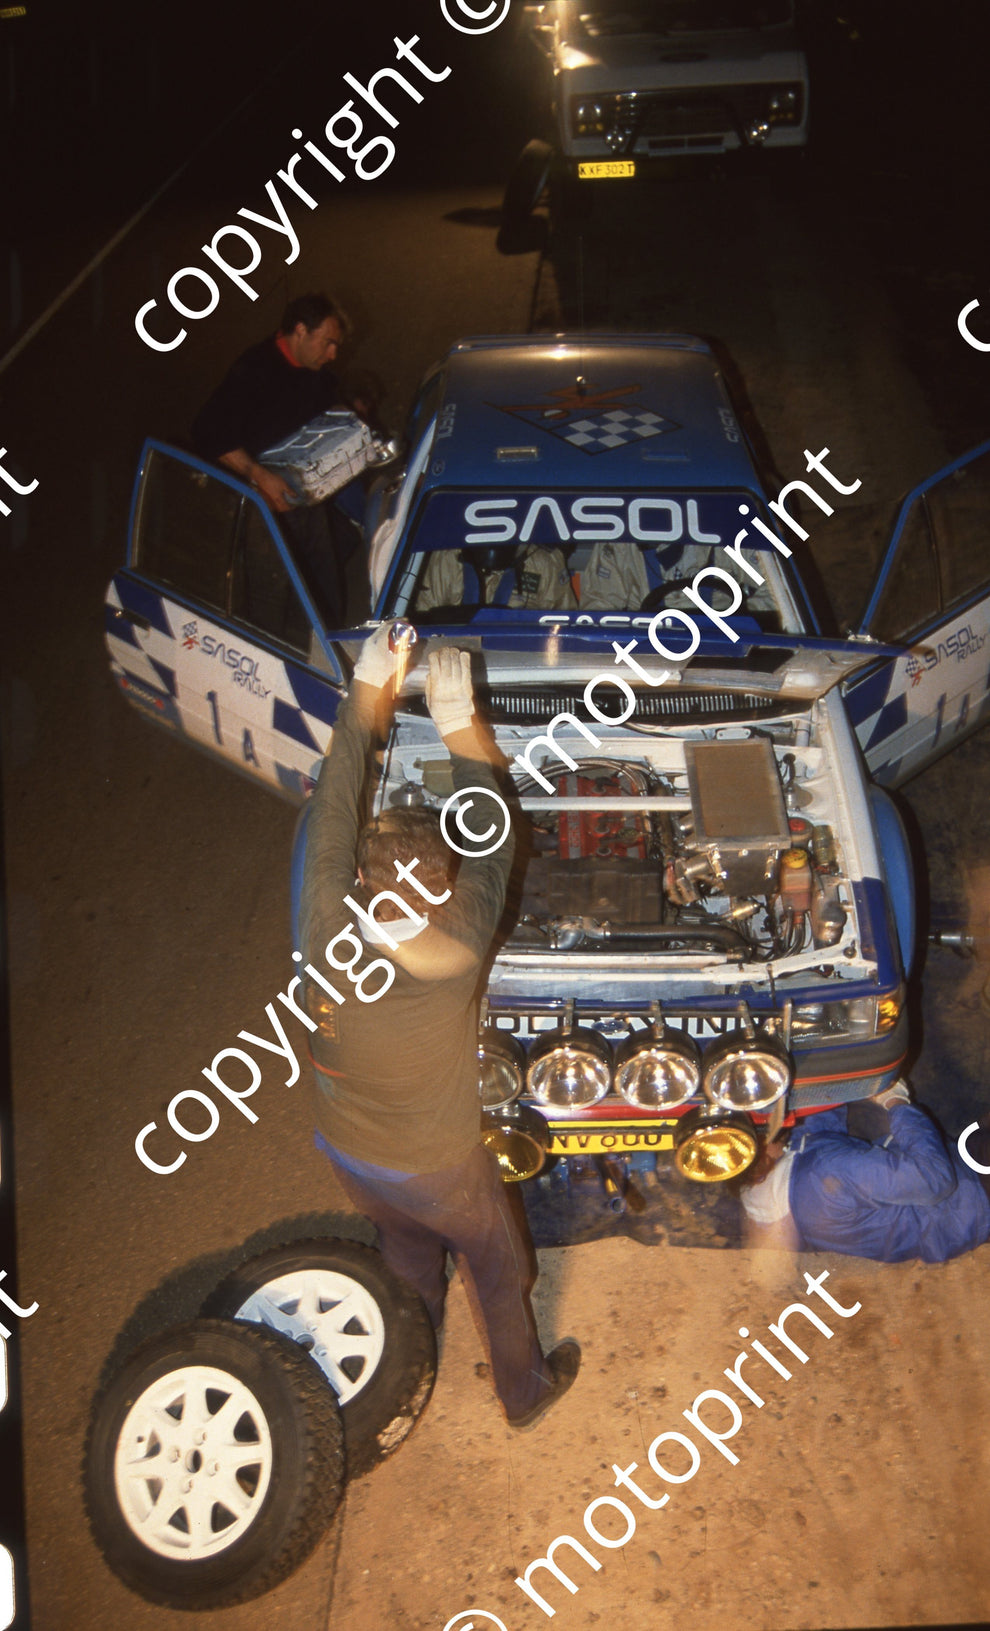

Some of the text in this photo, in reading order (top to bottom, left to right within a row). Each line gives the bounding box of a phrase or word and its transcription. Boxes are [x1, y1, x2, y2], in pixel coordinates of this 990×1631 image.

[464, 496, 722, 543] SASOL
[201, 635, 261, 682] SASOL
[923, 624, 978, 671] SASOL
[957, 633, 987, 664] RALLY
[233, 671, 272, 699] RALLY
